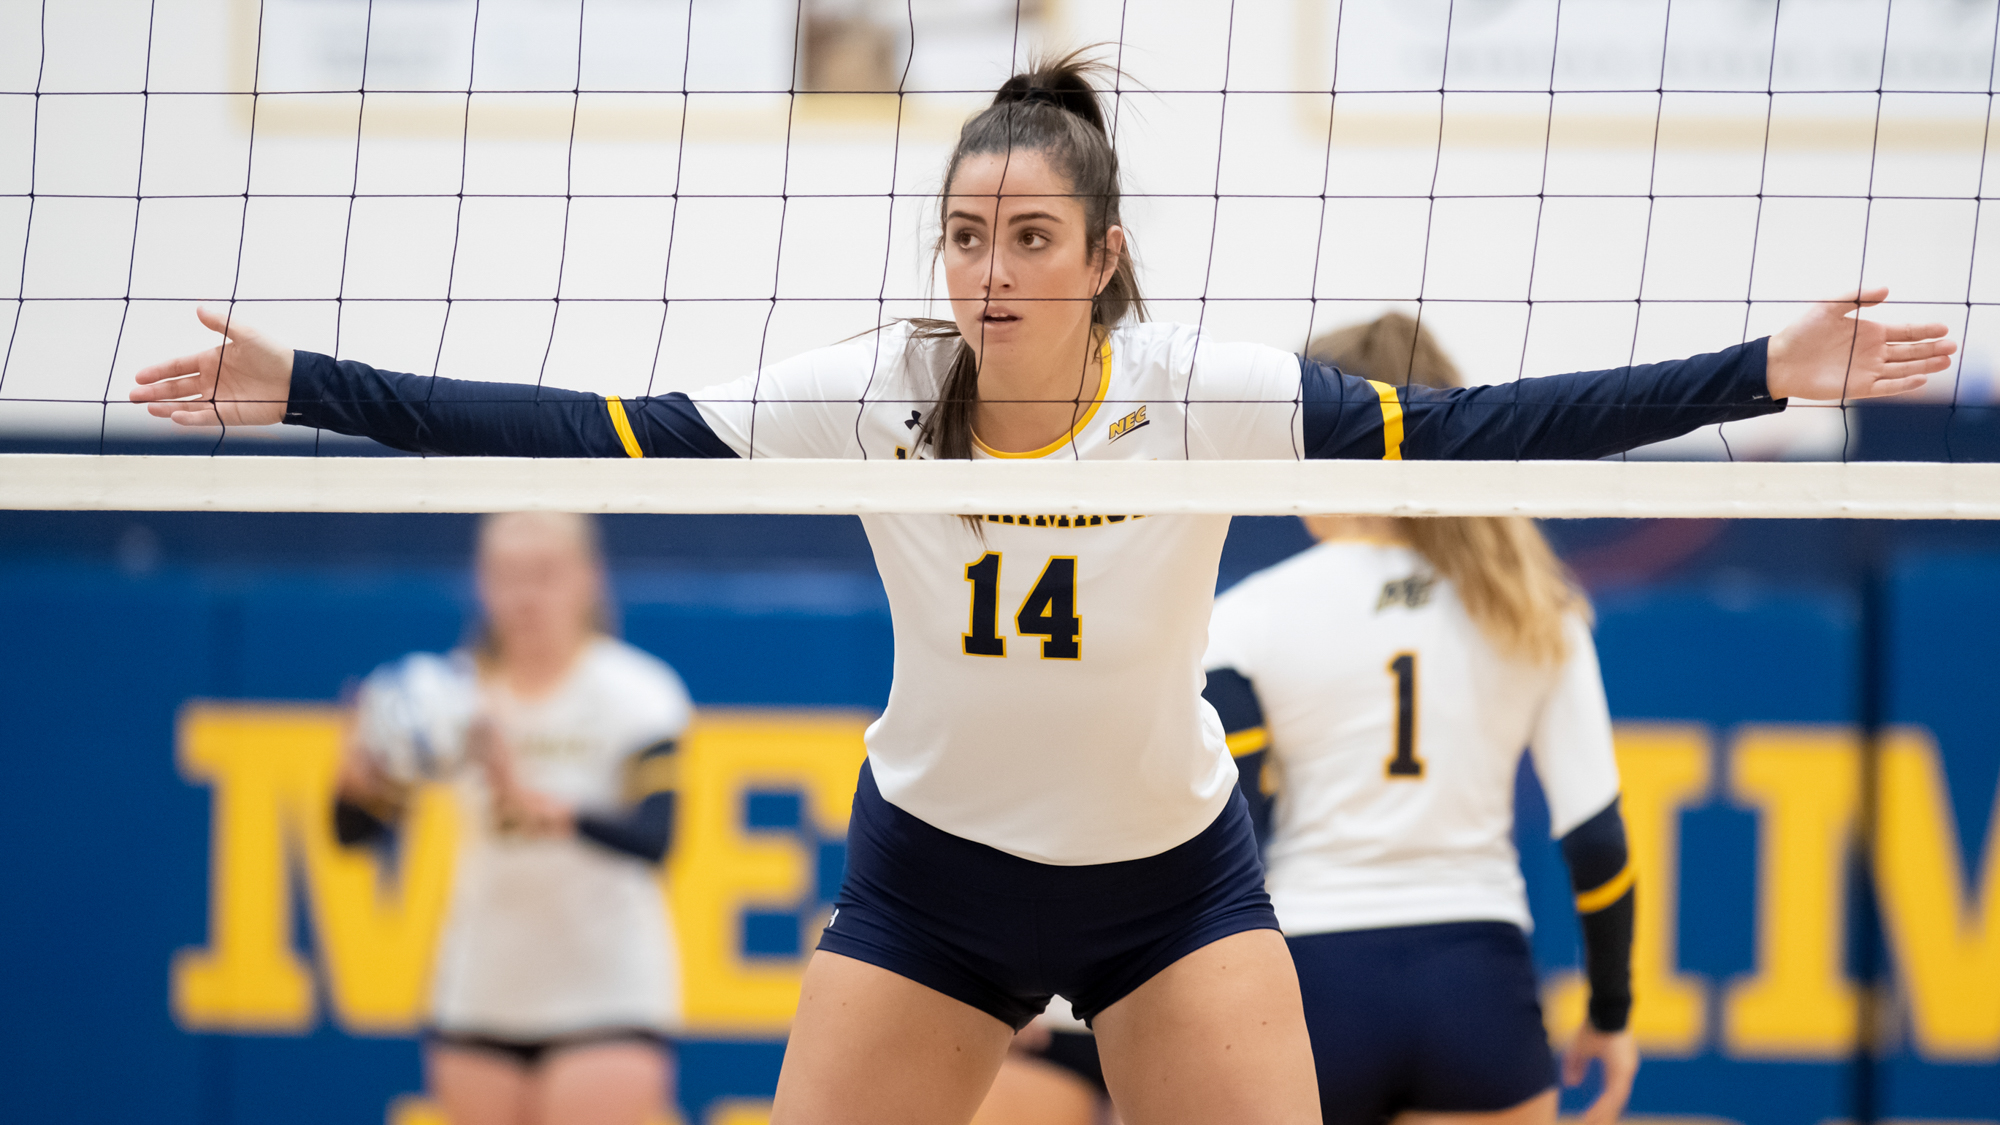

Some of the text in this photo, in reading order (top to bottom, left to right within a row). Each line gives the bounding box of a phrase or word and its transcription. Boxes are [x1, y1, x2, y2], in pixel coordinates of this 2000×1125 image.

[1109, 404, 1147, 440] NEC
[961, 550, 1083, 661] 14
[1383, 649, 1426, 781] 1
